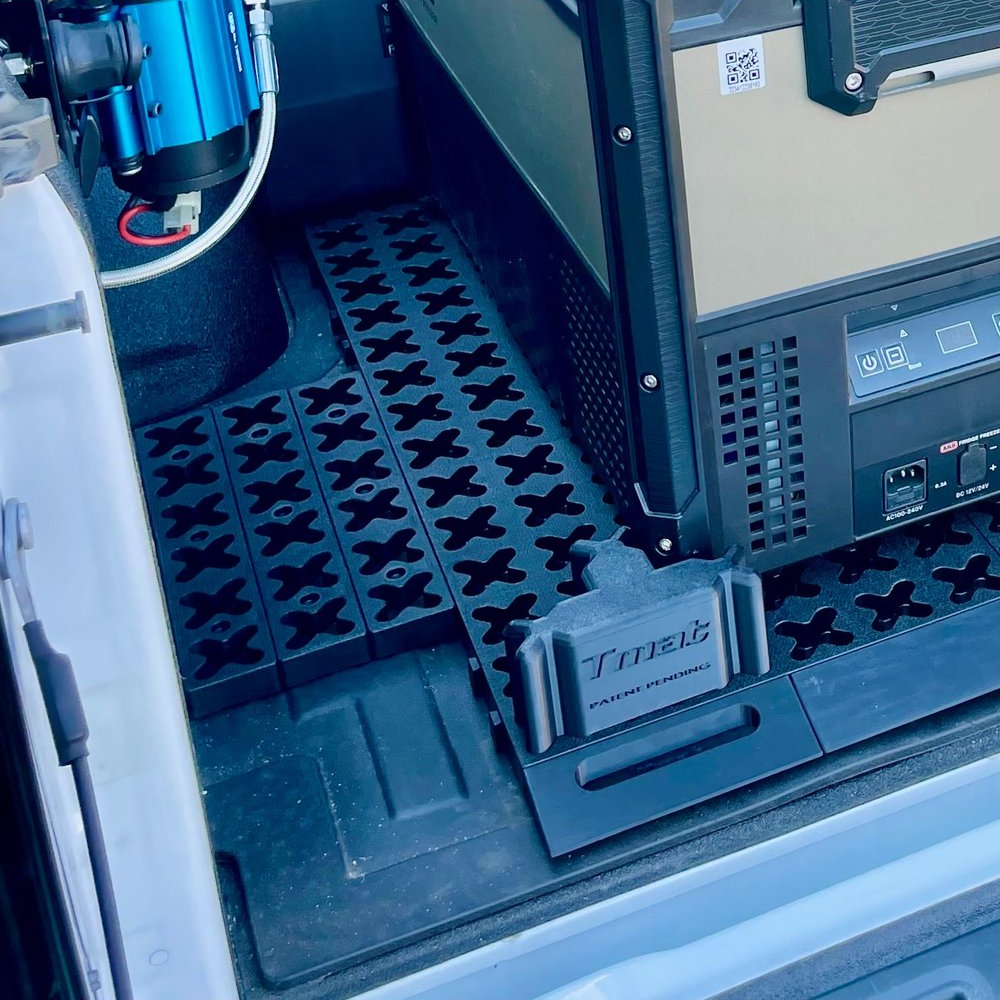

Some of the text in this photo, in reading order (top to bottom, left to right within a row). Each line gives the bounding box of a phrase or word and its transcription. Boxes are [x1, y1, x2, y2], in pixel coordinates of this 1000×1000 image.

[958, 434, 979, 446] FRIDGE
[955, 490, 965, 499] DC
[885, 504, 924, 522] AC100-240V
[581, 619, 711, 681] Tmat
[589, 662, 712, 710] PATENT PENDING
